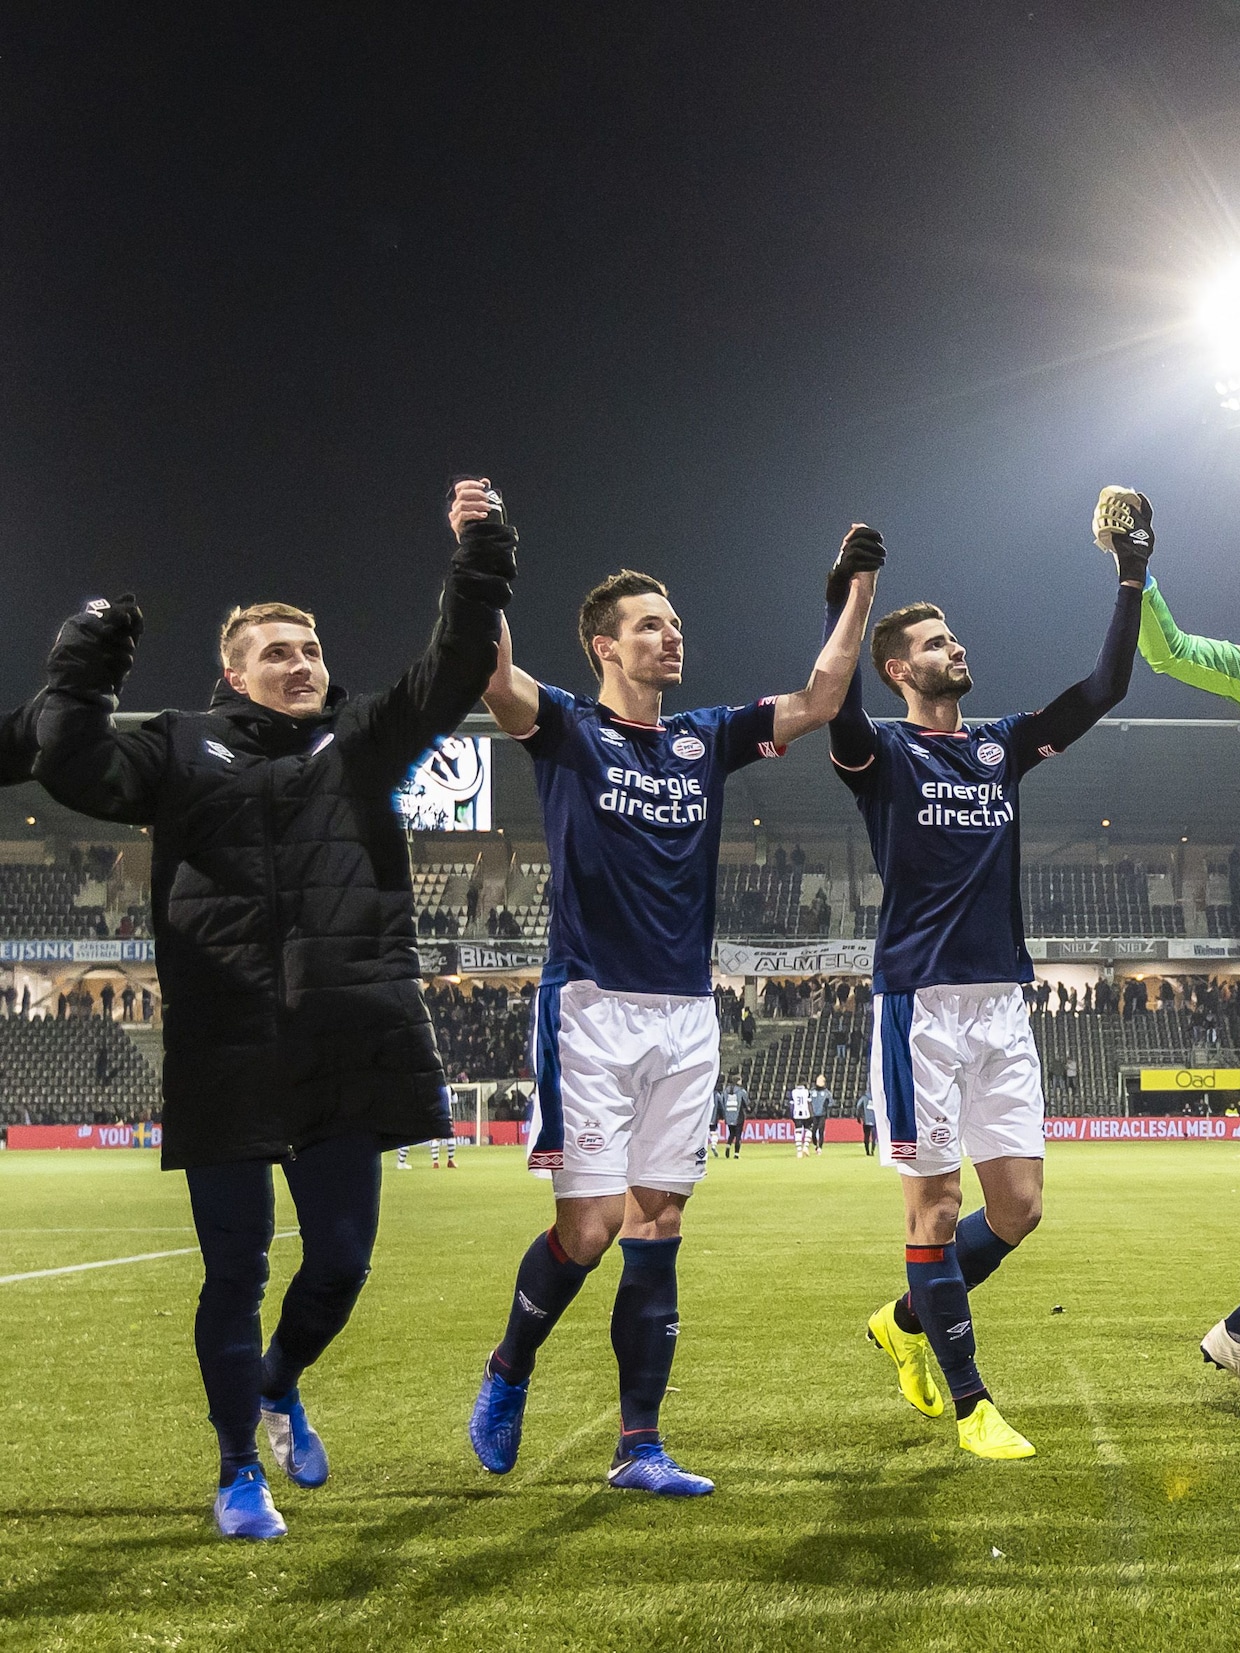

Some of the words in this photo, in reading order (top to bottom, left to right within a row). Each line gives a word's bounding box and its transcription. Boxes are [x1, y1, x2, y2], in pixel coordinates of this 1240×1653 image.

[607, 766, 702, 800] energie
[921, 781, 1004, 805] energie
[599, 787, 708, 824] direct.nl
[917, 801, 1014, 827] direct.nl
[754, 953, 873, 971] ALMELO
[1175, 1070, 1215, 1088] Oad
[1090, 1120, 1226, 1138] HERACLESALMELO
